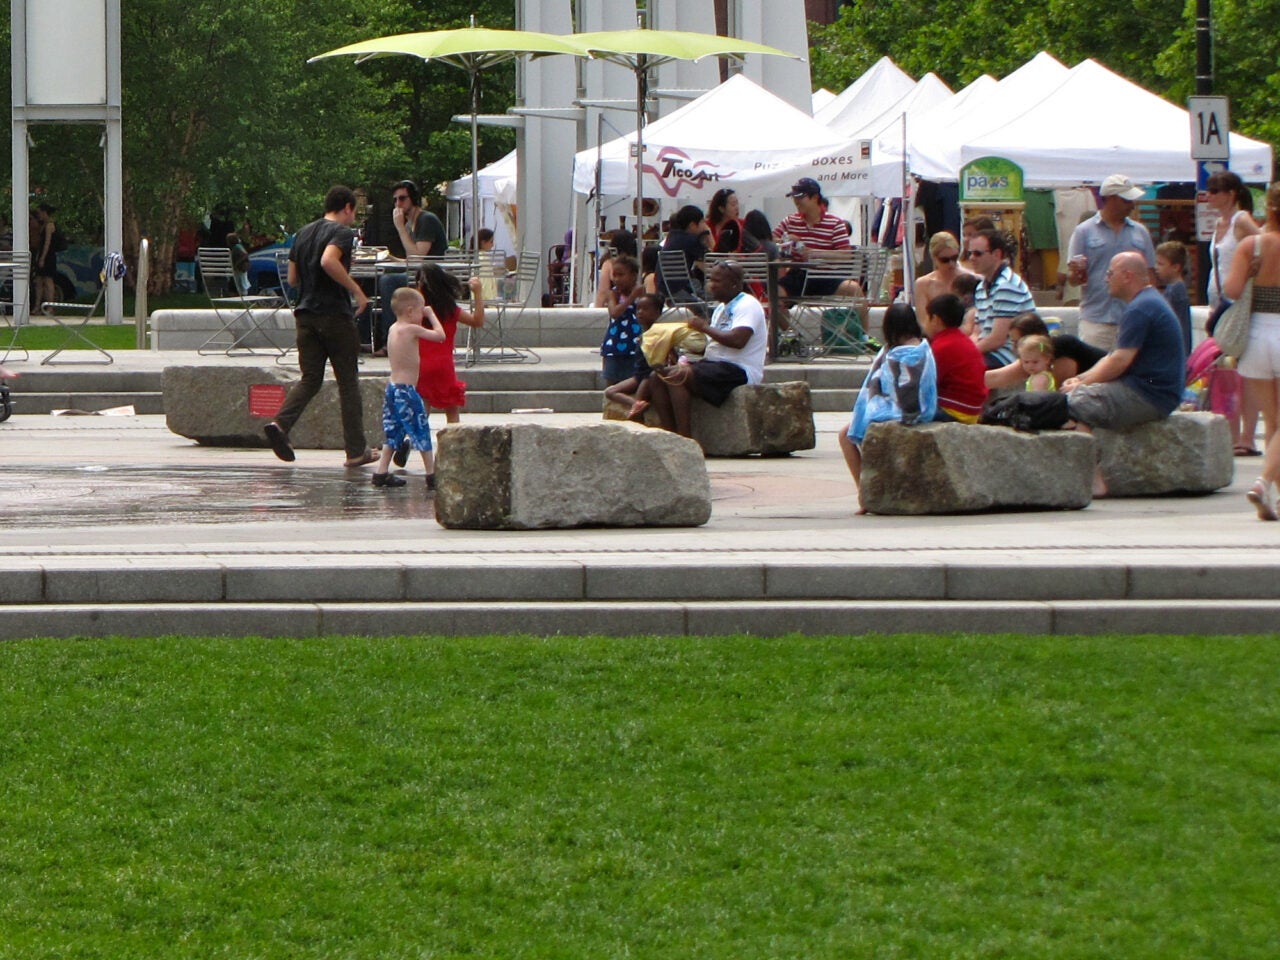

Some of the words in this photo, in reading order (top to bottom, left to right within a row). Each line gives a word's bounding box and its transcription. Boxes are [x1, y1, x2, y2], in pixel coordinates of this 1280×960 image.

[1197, 111, 1222, 145] 1A
[661, 157, 693, 178] Tico
[690, 169, 720, 182] Art
[812, 155, 853, 166] Boxes
[817, 172, 837, 181] and
[840, 172, 869, 180] More
